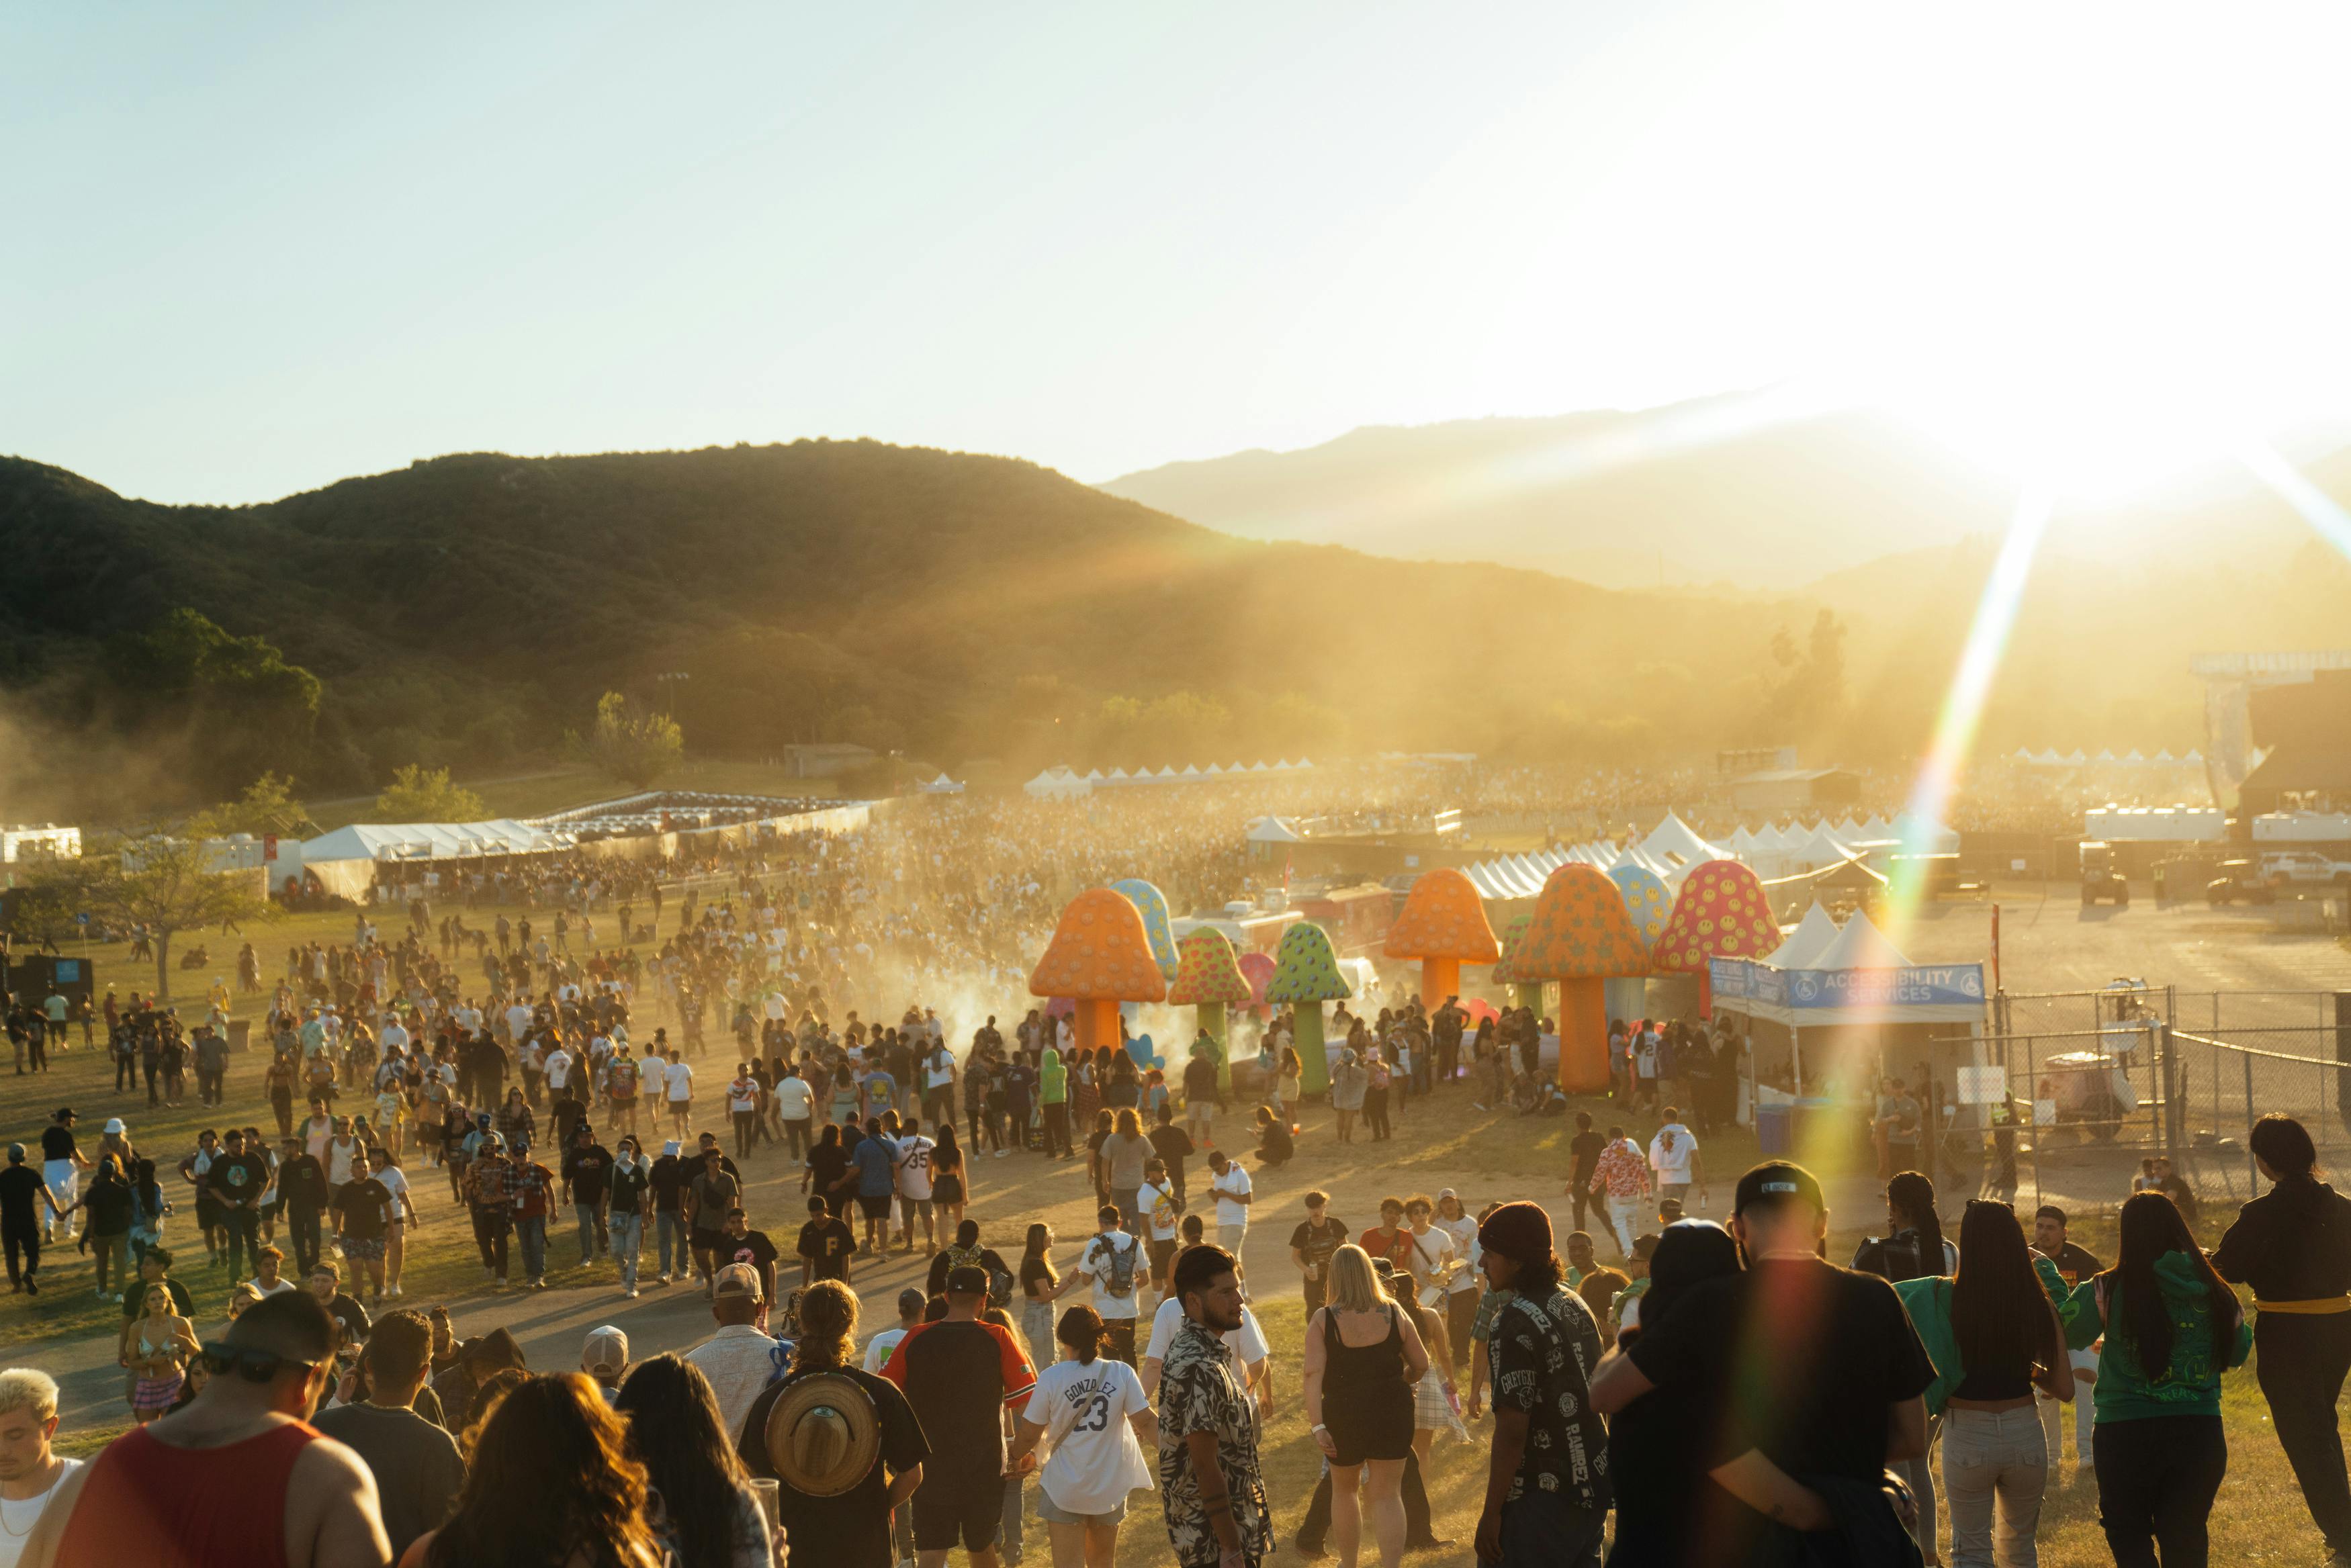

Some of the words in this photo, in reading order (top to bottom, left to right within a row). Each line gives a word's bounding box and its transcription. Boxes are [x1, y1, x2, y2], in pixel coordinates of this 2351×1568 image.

[1824, 970, 1953, 988] ACCESSIBILITY
[1847, 986, 1932, 1003] SERVICES
[908, 1151, 928, 1169] 35
[1073, 1395, 1108, 1432] 23
[1565, 1423, 1589, 1486] RAMIREZ
